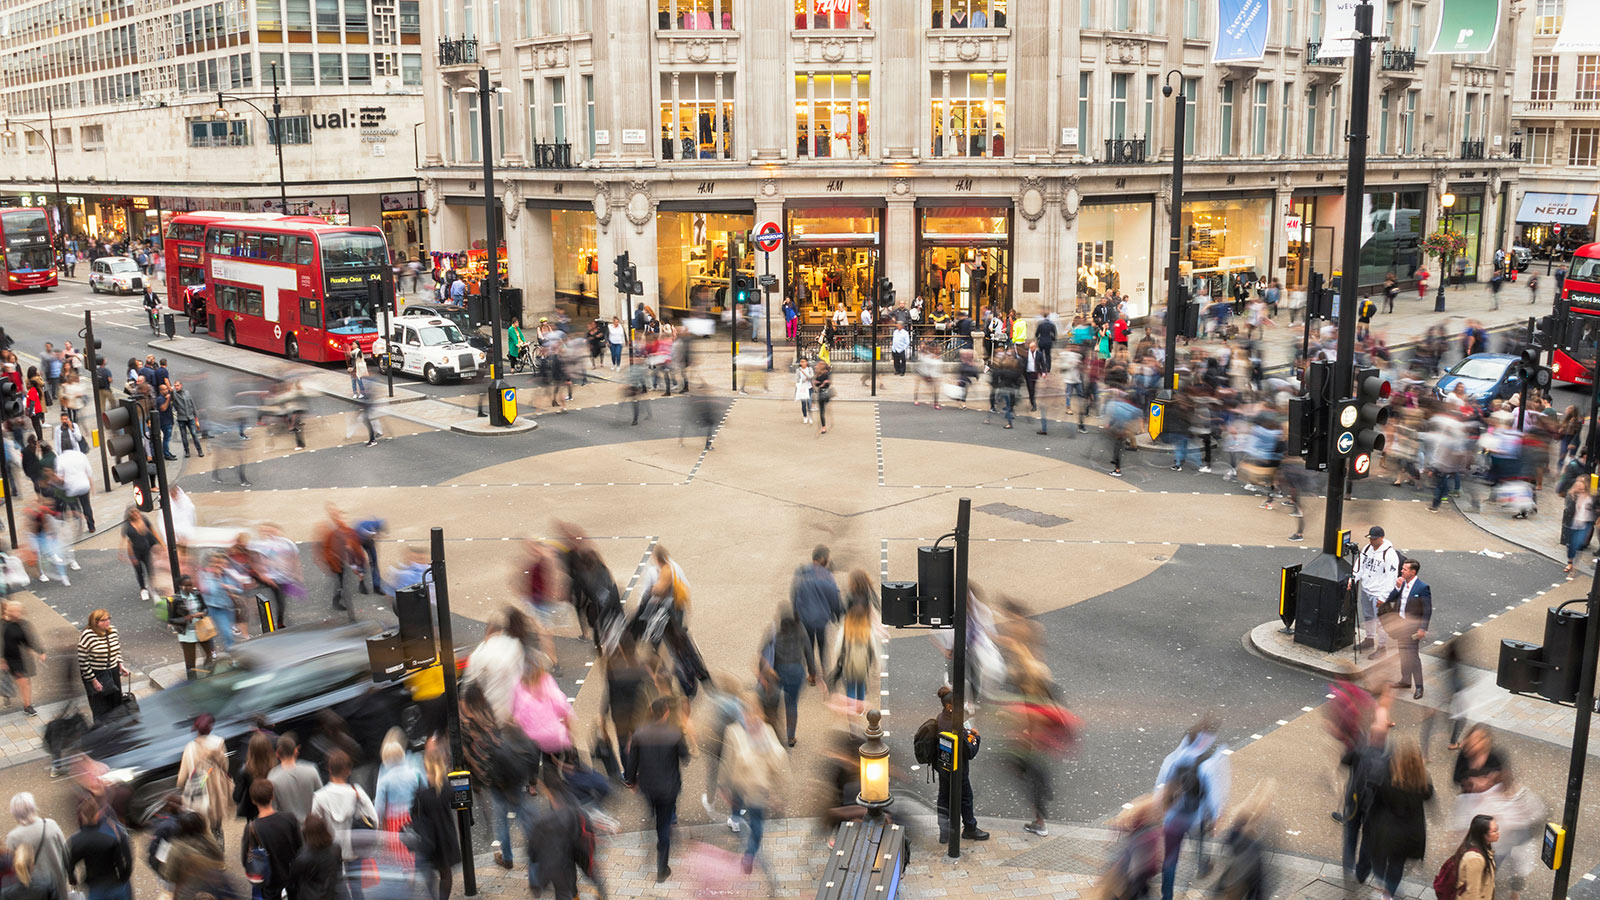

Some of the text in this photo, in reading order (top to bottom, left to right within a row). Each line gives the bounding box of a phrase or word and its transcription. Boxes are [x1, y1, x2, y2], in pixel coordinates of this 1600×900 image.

[1226, 0, 1253, 35] Everyon
[1234, 1, 1262, 39] welcome
[698, 182, 715, 194] H&M
[827, 180, 843, 192] H&M
[955, 180, 973, 191] H&M
[1535, 207, 1578, 215] NERO
[757, 233, 784, 241] UNDERGROUND
[1571, 294, 1592, 303] Deptford
